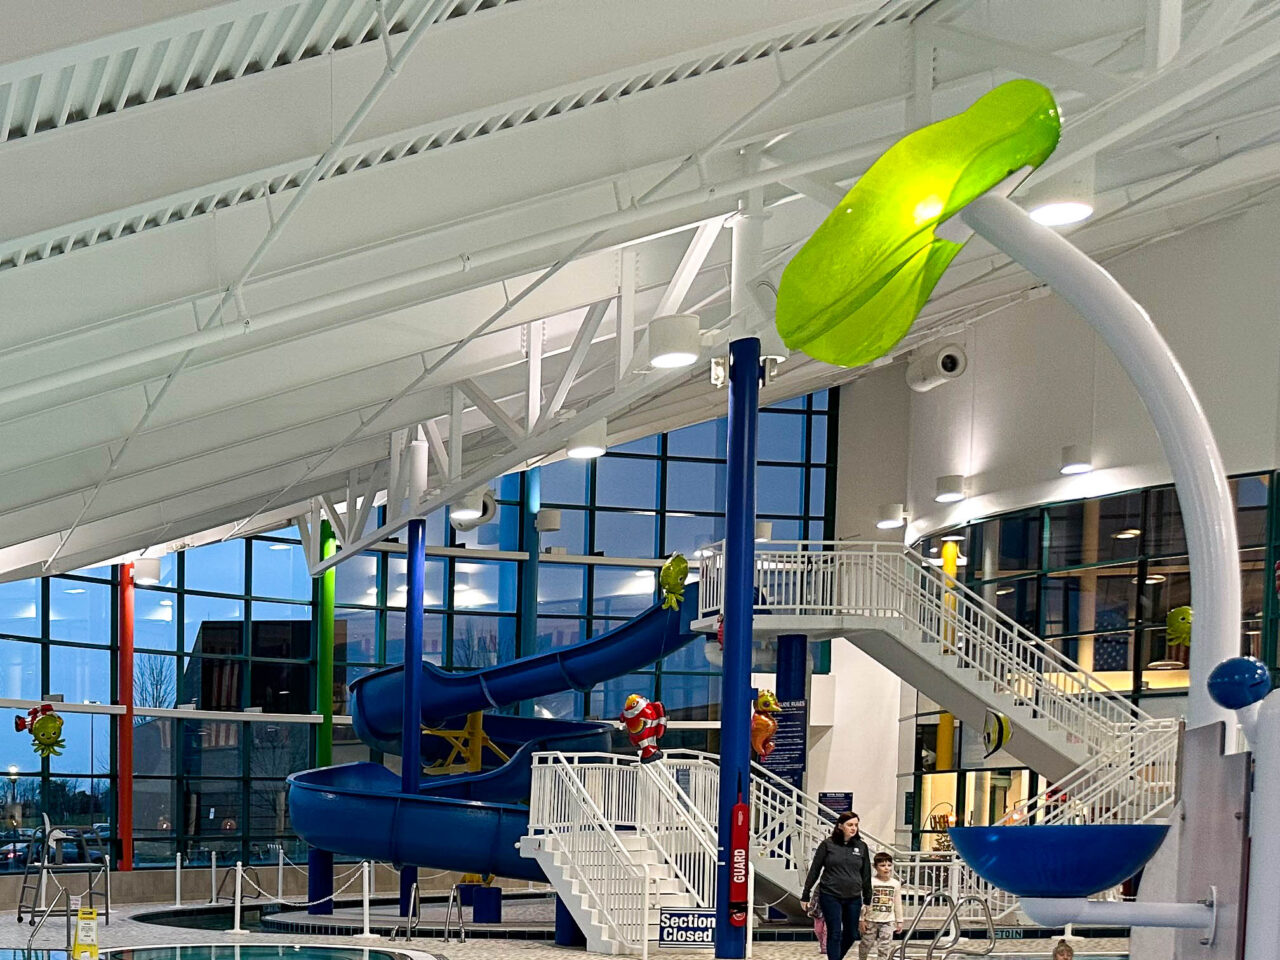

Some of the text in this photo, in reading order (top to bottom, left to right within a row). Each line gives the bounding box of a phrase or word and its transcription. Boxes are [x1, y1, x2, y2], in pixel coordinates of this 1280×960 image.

[733, 849, 746, 883] GUARD
[660, 914, 716, 928] Section
[663, 928, 713, 941] Closed
